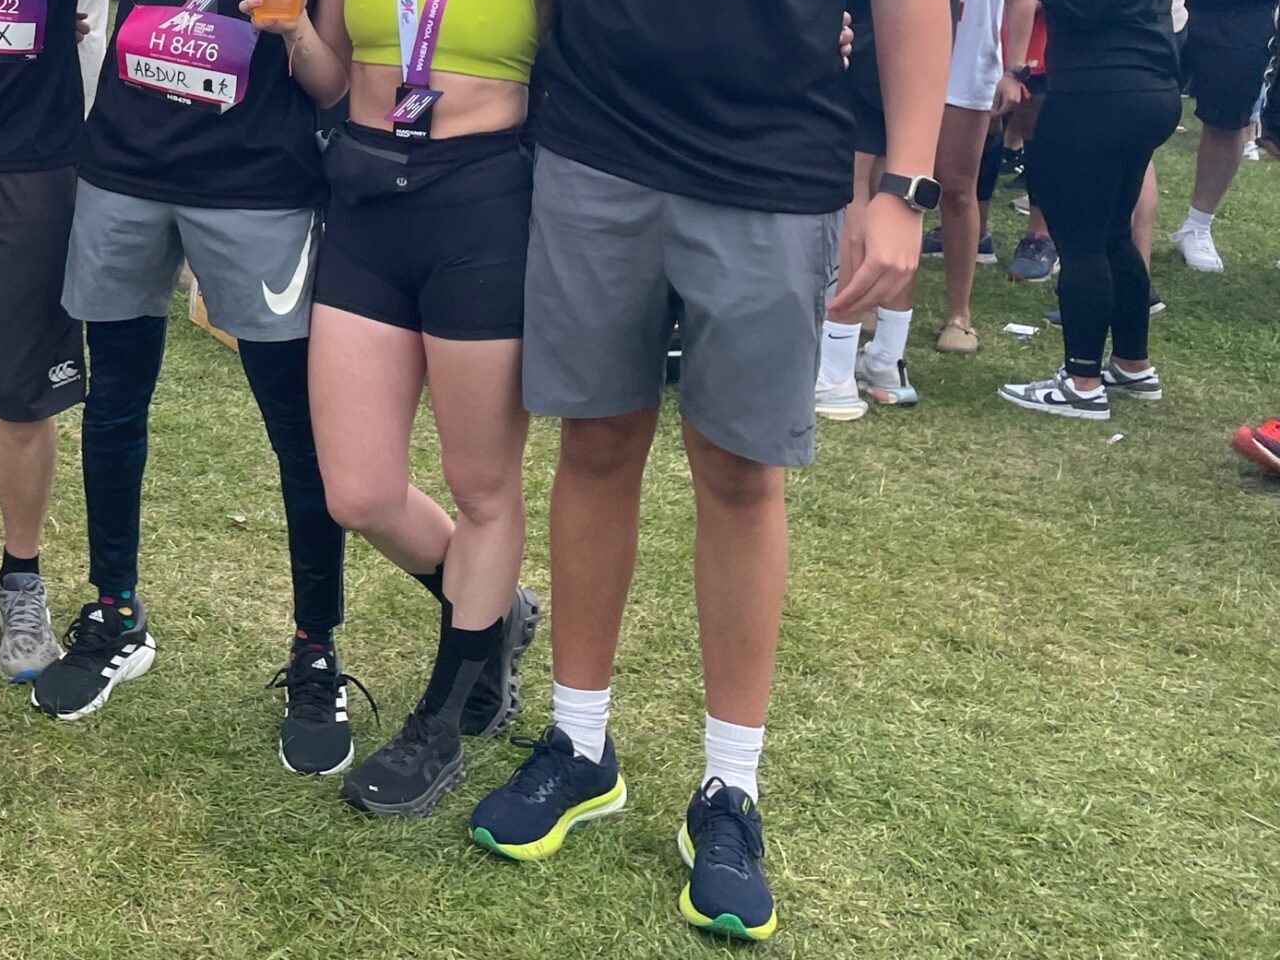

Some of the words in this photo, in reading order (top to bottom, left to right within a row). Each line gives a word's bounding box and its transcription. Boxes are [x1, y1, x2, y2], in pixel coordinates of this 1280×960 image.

[149, 31, 165, 51] H
[170, 36, 219, 62] 8476
[416, 41, 429, 73] WHEN
[423, 19, 434, 40] YOU
